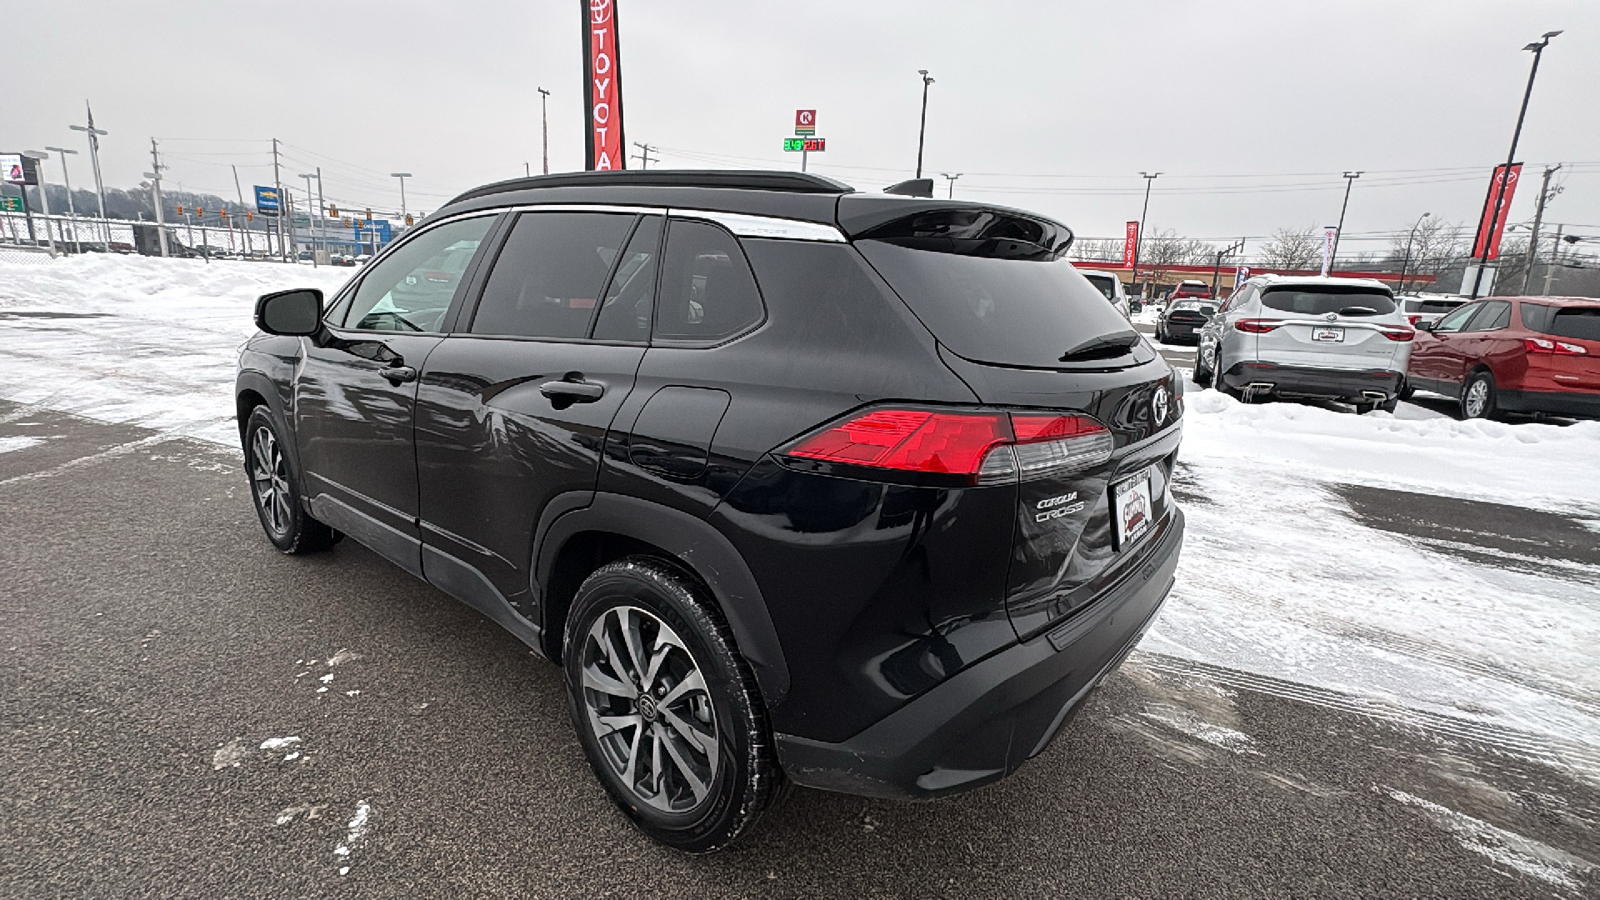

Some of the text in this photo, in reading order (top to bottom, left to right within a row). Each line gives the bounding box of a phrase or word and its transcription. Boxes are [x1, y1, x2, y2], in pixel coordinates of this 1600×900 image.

[593, 28, 612, 171] TOYOTA
[1126, 231, 1134, 267] TOYOTA
[1035, 501, 1085, 523] CROSS
